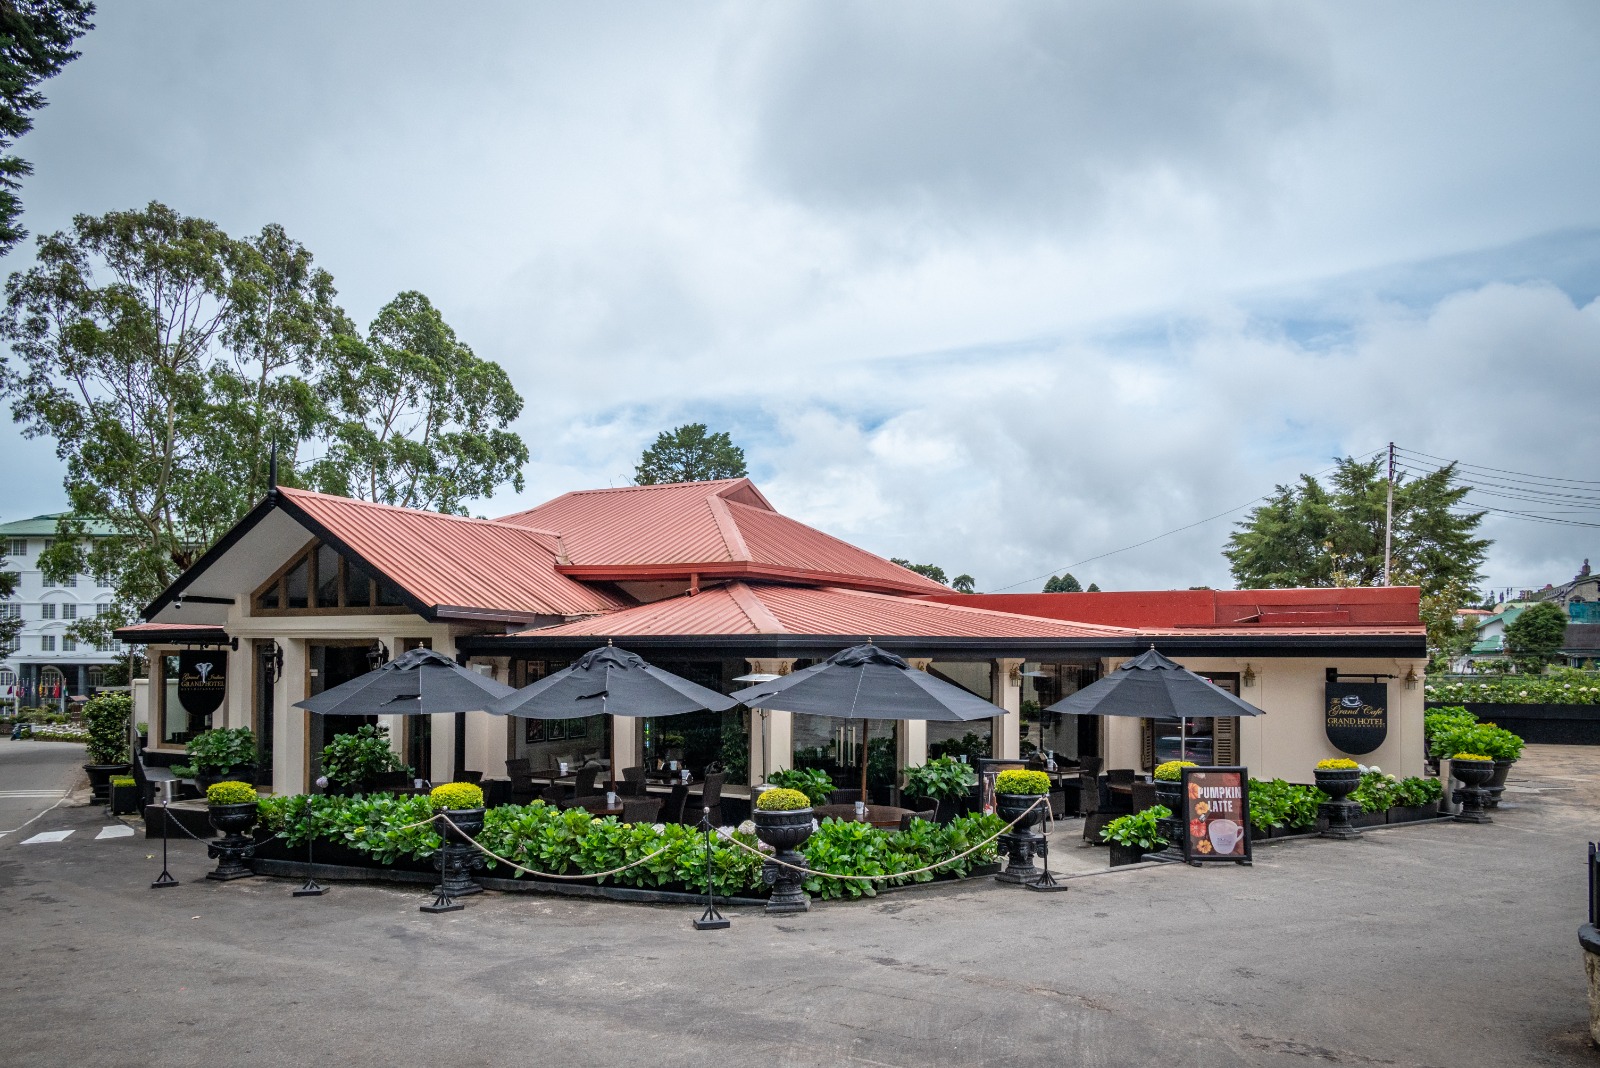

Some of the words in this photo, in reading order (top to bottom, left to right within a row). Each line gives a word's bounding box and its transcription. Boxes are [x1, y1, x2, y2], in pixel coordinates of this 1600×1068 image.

[1328, 704, 1360, 716] Grand
[1327, 717, 1356, 725] GRAND
[1357, 717, 1383, 725] HOTEL
[1198, 786, 1243, 799] PUMPKIN
[1208, 800, 1233, 812] LATTE
